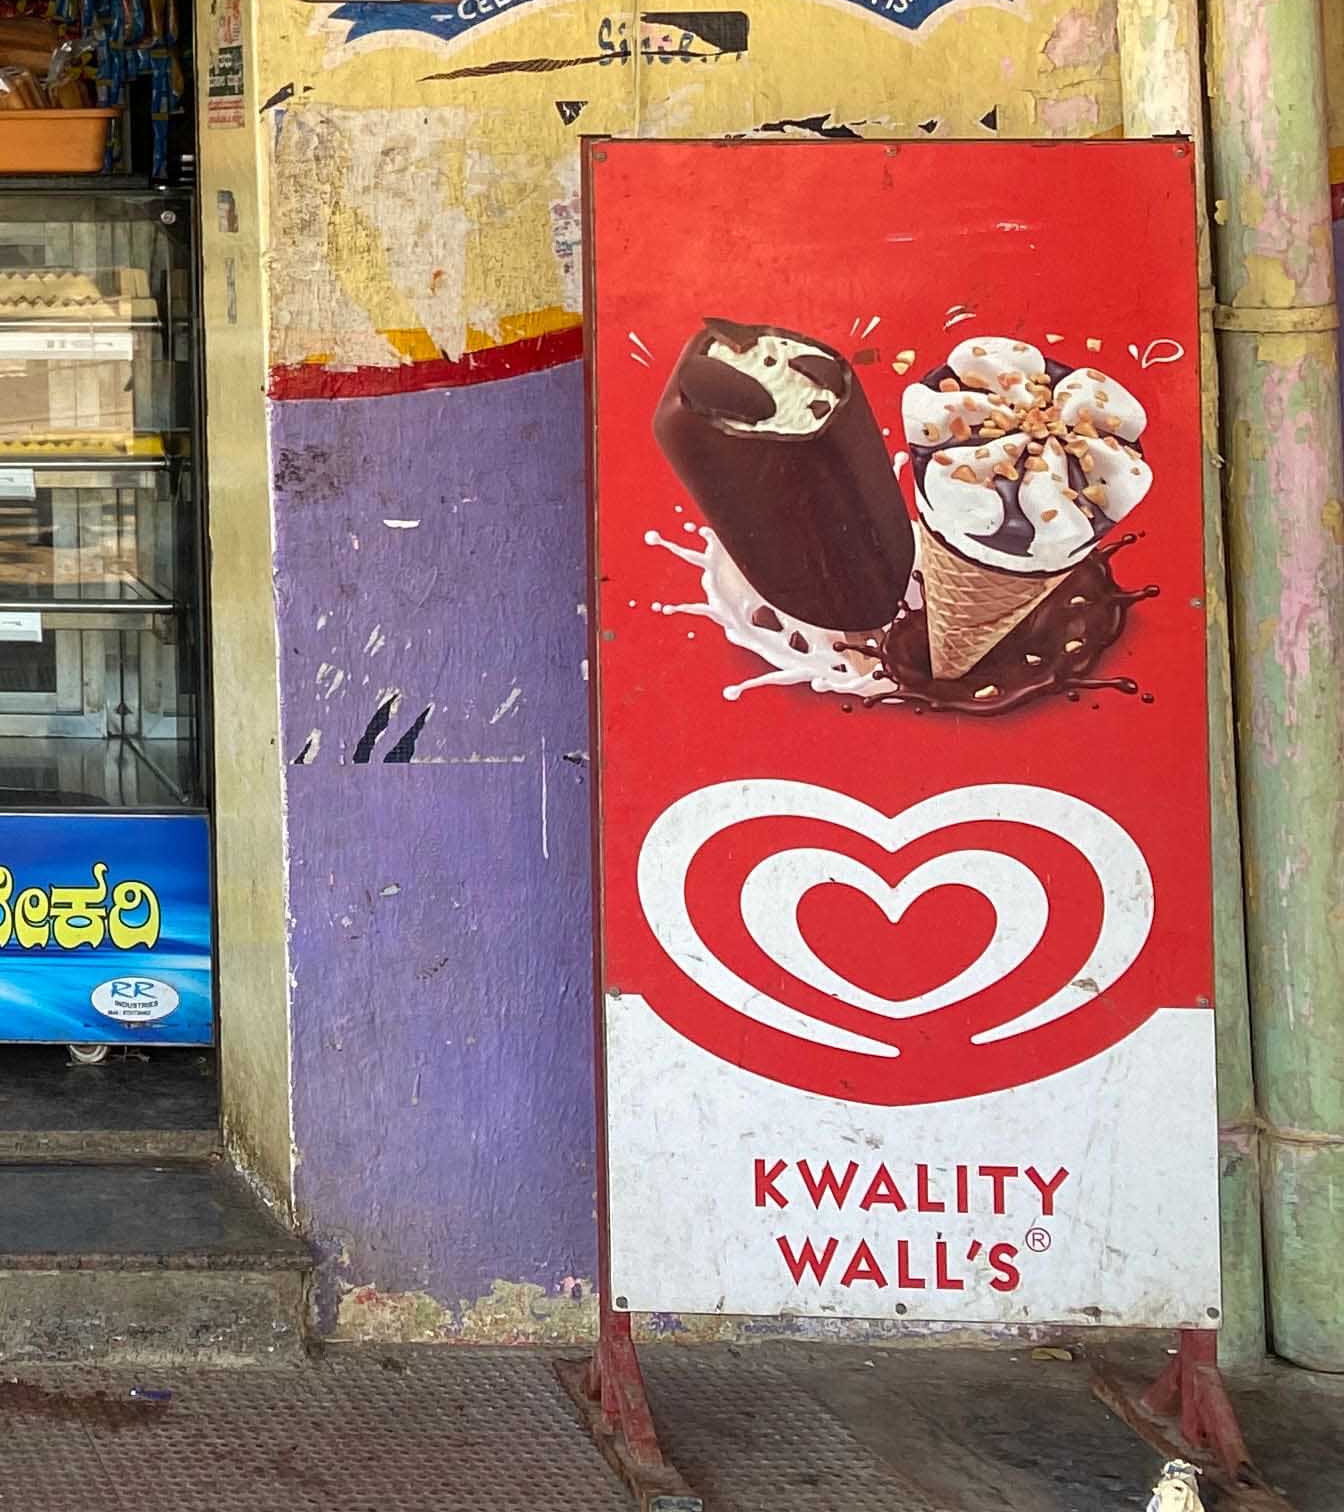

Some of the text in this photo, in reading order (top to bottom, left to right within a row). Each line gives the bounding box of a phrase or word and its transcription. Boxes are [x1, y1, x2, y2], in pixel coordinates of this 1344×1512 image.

[111, 981, 157, 999] RR
[753, 1158, 1070, 1217] KWALITY
[776, 1235, 1022, 1294] WALL'S
